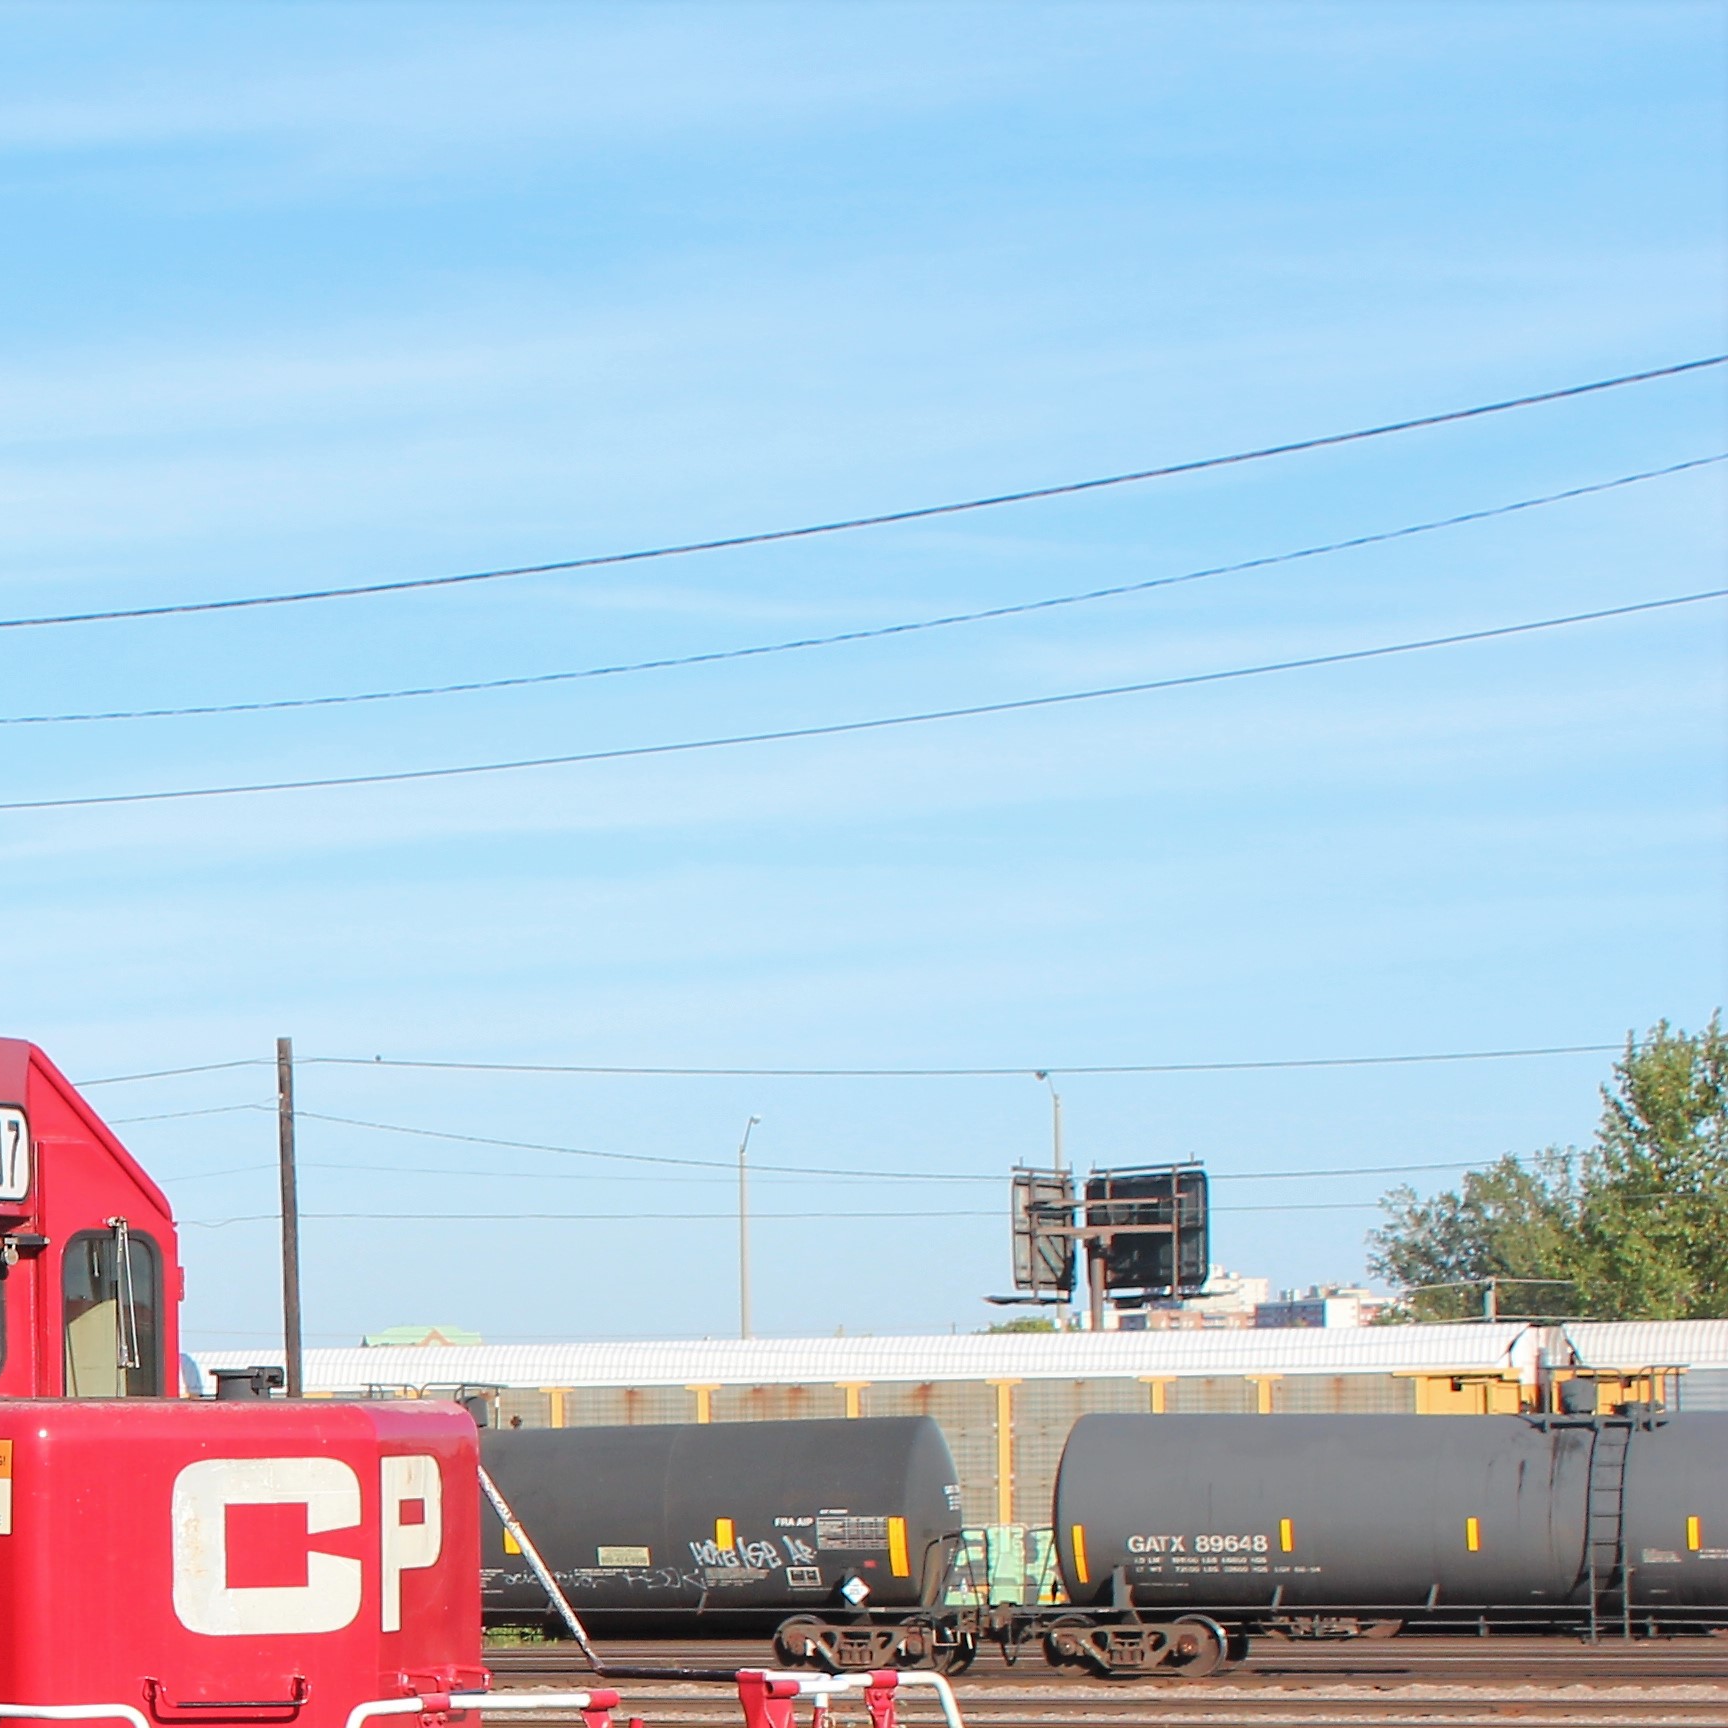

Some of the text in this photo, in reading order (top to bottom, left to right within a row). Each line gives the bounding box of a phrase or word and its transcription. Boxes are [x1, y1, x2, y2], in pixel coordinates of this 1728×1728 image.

[170, 1454, 442, 1637] CP
[1127, 1535, 1269, 1553] GATX 89648
